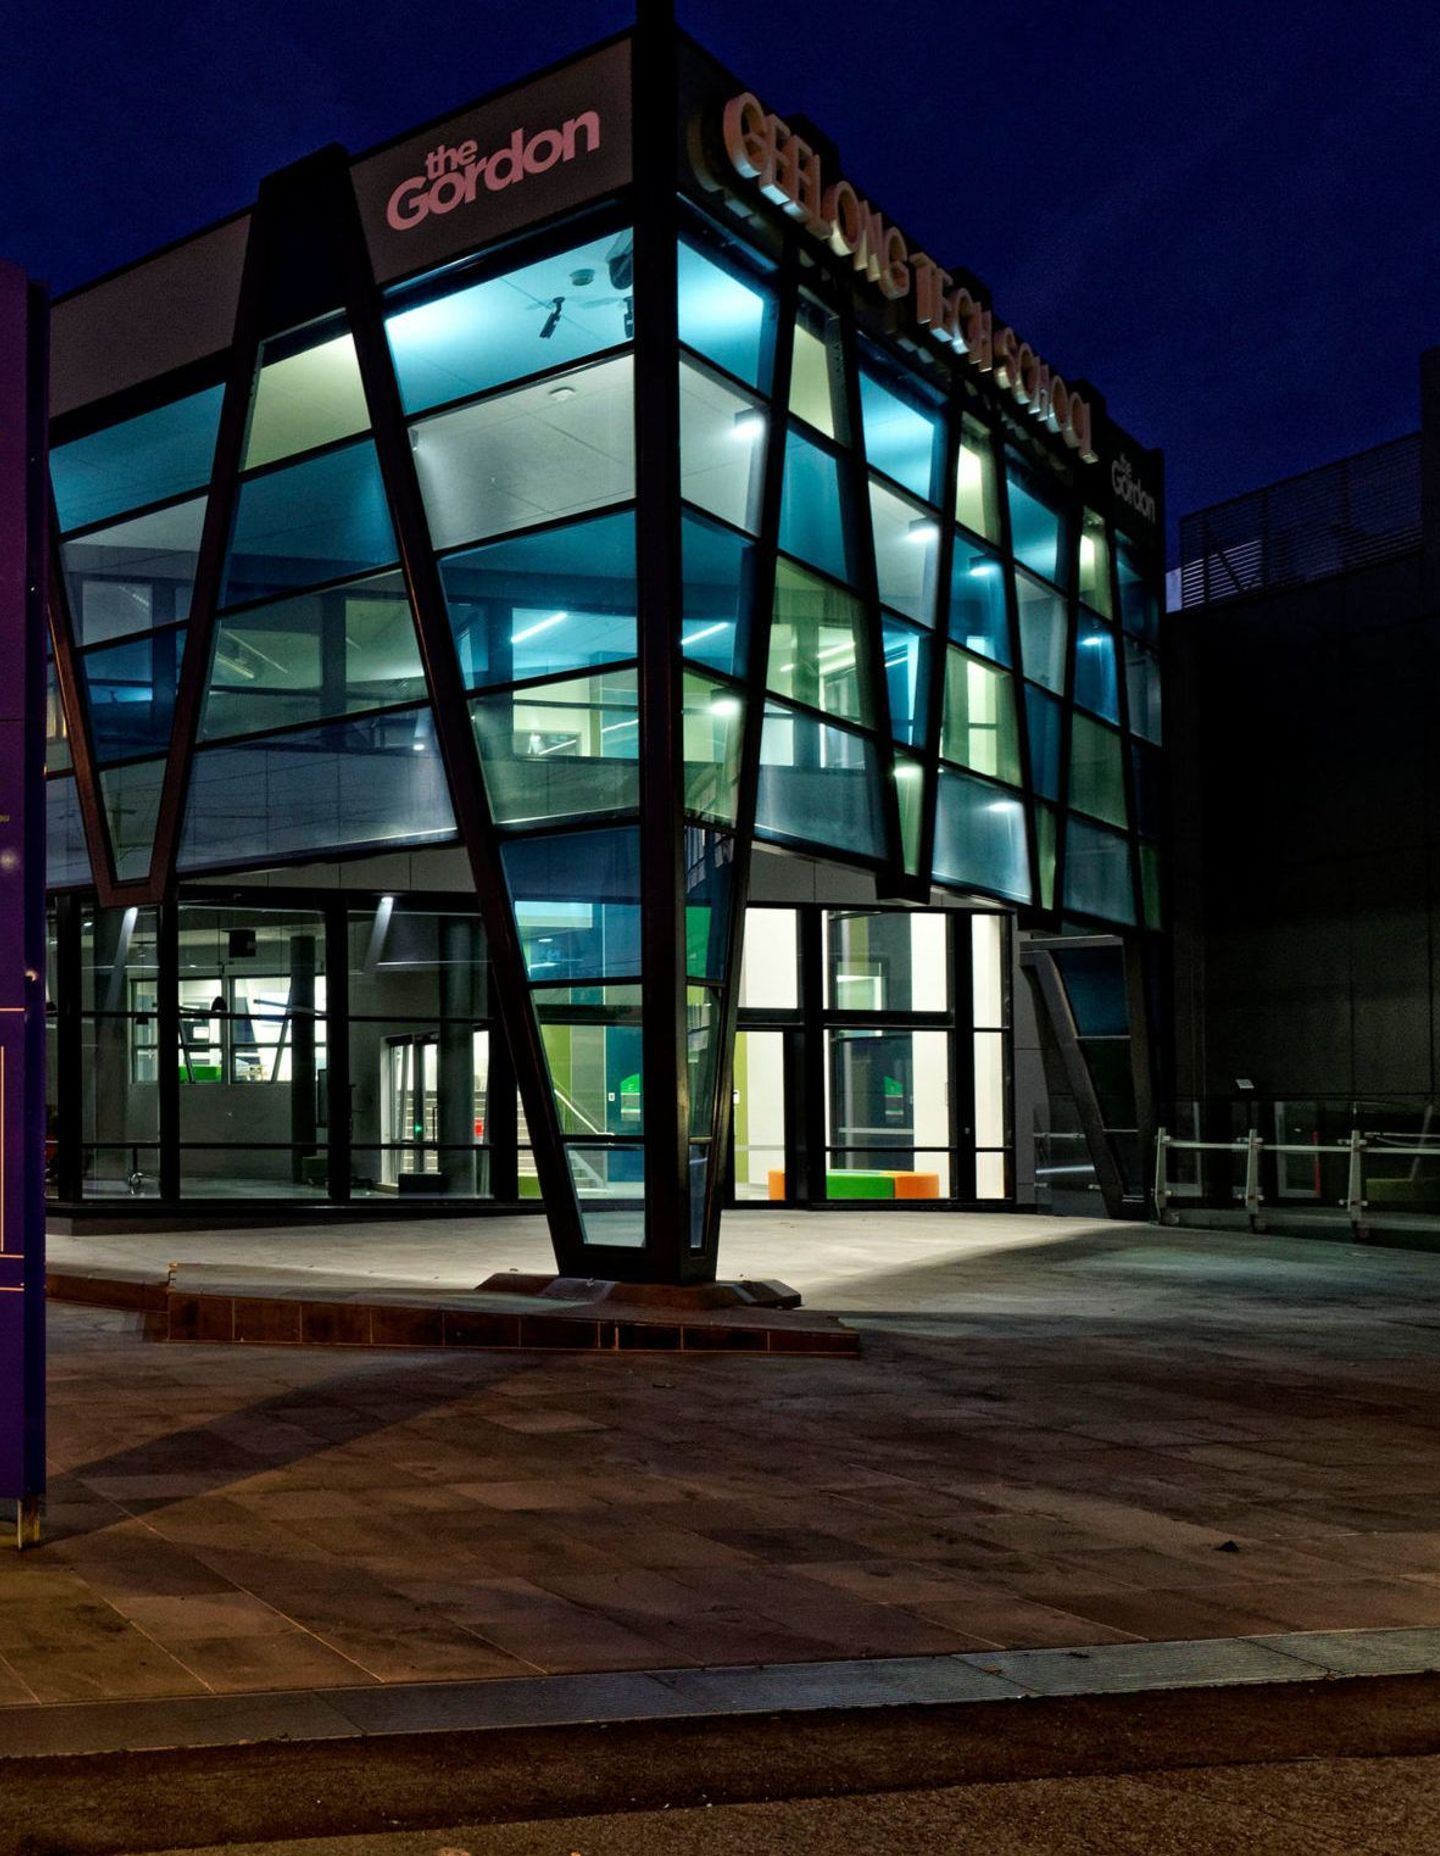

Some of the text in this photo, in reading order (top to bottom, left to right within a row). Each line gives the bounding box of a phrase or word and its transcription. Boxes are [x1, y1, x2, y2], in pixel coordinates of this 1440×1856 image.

[386, 110, 601, 231] Gordon
[425, 139, 478, 180] the
[910, 252, 993, 373] TECH
